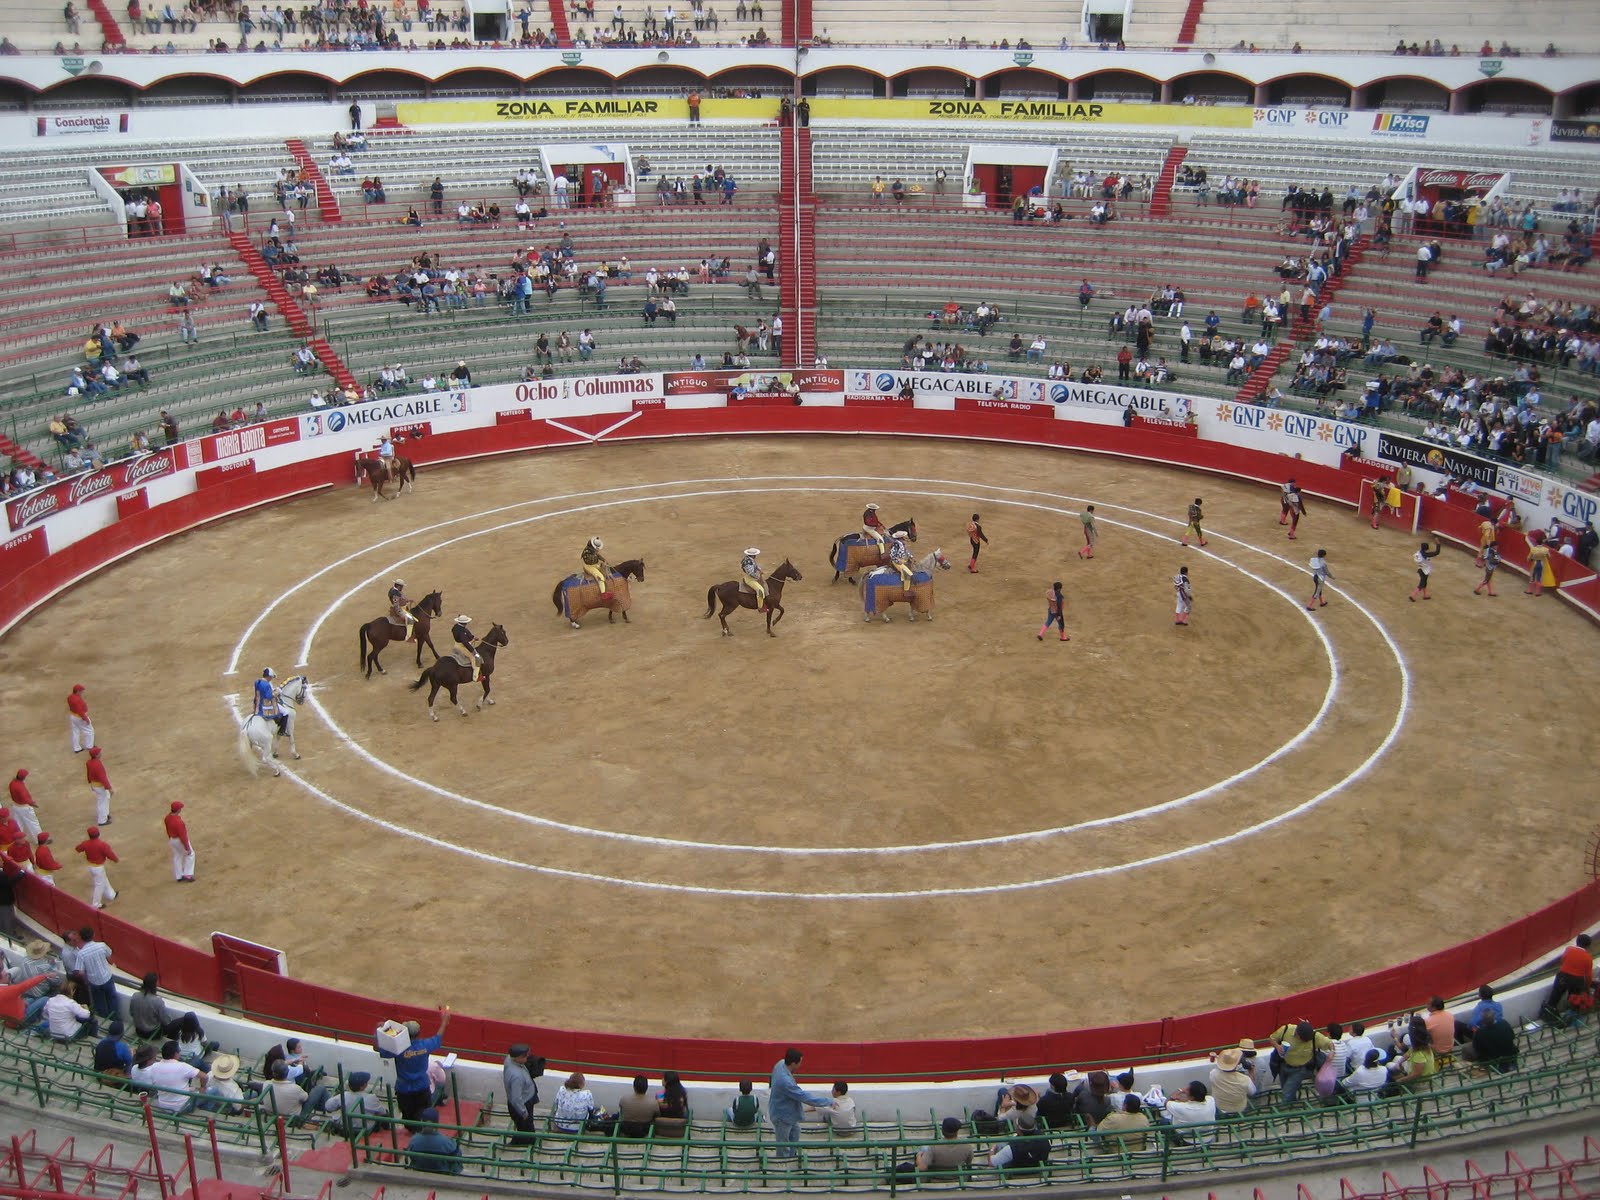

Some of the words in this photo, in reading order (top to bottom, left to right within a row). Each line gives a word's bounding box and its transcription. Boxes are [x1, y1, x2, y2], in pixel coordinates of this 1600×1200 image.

[496, 102, 554, 116] ZONA
[565, 101, 658, 114] FAMILIAR
[929, 102, 986, 115] ZONA
[1001, 103, 1103, 117] FAMILIAR
[1267, 109, 1297, 123] GNP
[55, 115, 111, 128] Conciencia
[1319, 112, 1349, 126] GNP
[1392, 115, 1426, 129] Prisa
[1551, 126, 1585, 137] RIVIERA
[1419, 165, 1458, 185] Victoria
[515, 383, 558, 402] Ocho
[574, 378, 655, 397] Columnas
[667, 379, 708, 390] ANTIGUO
[800, 378, 840, 387] ANTIGUO
[896, 376, 993, 394] MEGACABLE
[977, 400, 1009, 408] TELEVISA
[1070, 389, 1167, 412] MEGACABLE
[347, 399, 441, 426] MEGACABLE
[500, 409, 525, 417] PORTEROS
[1233, 406, 1265, 428] GNP
[394, 423, 424, 433] PRENSA
[1142, 417, 1173, 427] TELEVISA
[1284, 414, 1317, 437] GNP
[1333, 424, 1367, 449] GNP
[125, 452, 169, 484] Victoria
[221, 459, 251, 473] DOCTORES
[1352, 456, 1395, 473] MATADORES
[1379, 438, 1429, 465] RIVIERA
[1442, 457, 1495, 484] NAYARIT
[69, 468, 112, 504] Victoria
[1497, 476, 1505, 486] A
[1508, 478, 1519, 492] TI
[15, 488, 58, 526] Victoria
[1562, 491, 1597, 523] GNP
[5, 532, 33, 551] PRENSA
